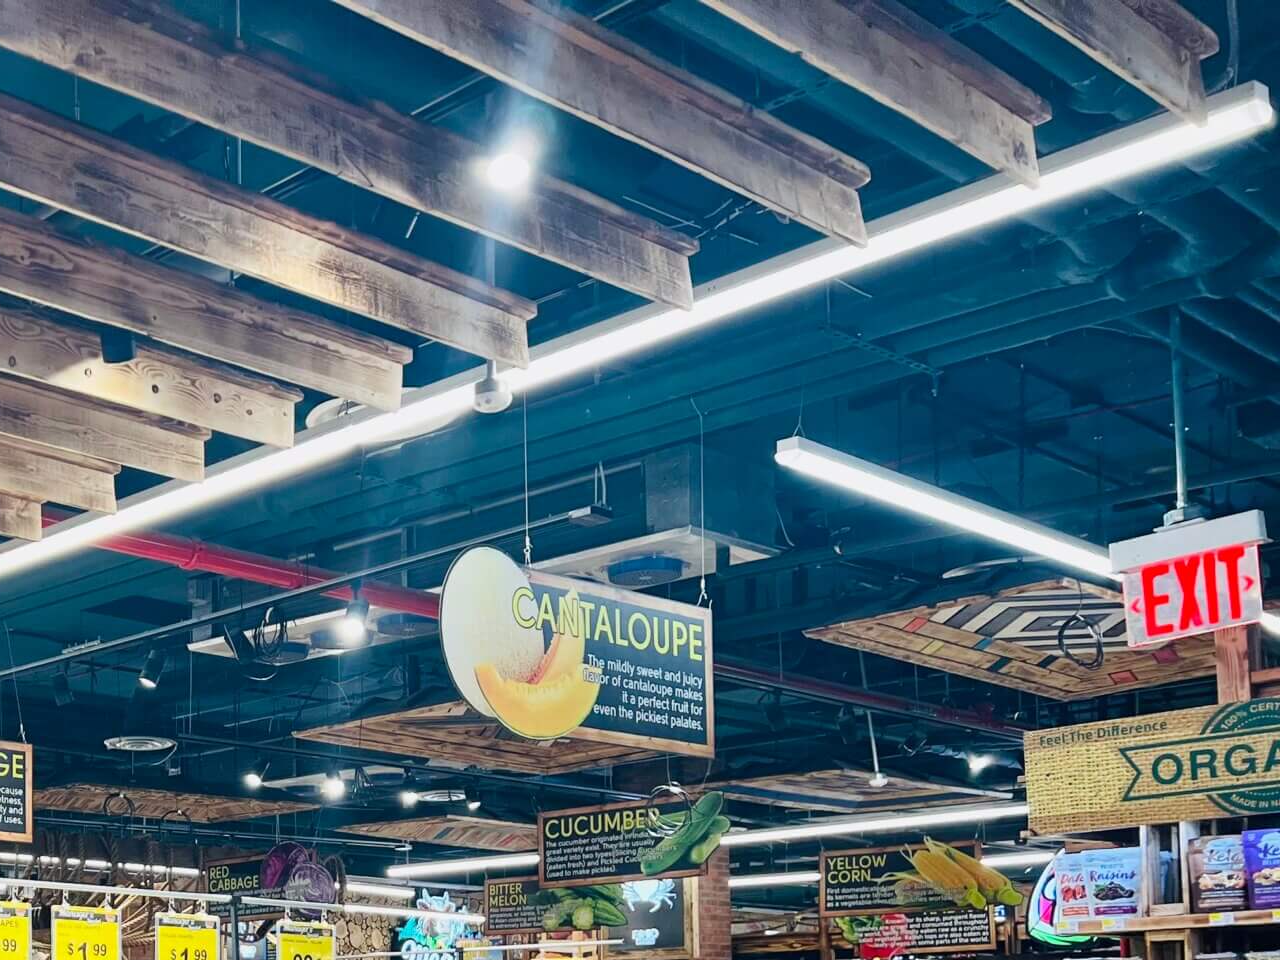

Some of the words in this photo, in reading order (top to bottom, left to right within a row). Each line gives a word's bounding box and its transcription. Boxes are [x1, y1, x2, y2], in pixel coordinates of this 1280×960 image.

[1140, 546, 1246, 637] EXIT
[511, 586, 703, 661] CANTALOUPE
[587, 653, 605, 670] The
[607, 658, 634, 678] mildly
[636, 664, 662, 679] sweet
[664, 667, 681, 682] and
[682, 672, 703, 689] juicy
[583, 667, 609, 684] flavor
[611, 671, 622, 686] of
[623, 677, 673, 699] cantaloupe
[675, 684, 703, 701] makes
[621, 691, 629, 704] it
[630, 694, 637, 705] a
[638, 696, 670, 714] perfect
[671, 702, 691, 715] fruit
[691, 704, 703, 716] for
[593, 704, 617, 718] even
[619, 706, 634, 720] the
[635, 708, 669, 727] pickiest
[670, 714, 704, 731] palates.
[1039, 735, 1066, 747] Feel
[1070, 730, 1093, 744] The
[1097, 719, 1168, 740] Difference
[9, 804, 23, 815] and
[545, 807, 660, 839] CUCUMBER
[209, 866, 230, 879] RED
[827, 854, 887, 870] YELLOW
[209, 875, 259, 892] CABBAGE
[827, 869, 871, 884] CORN
[489, 883, 522, 896] BITTER
[489, 895, 527, 908] MELON
